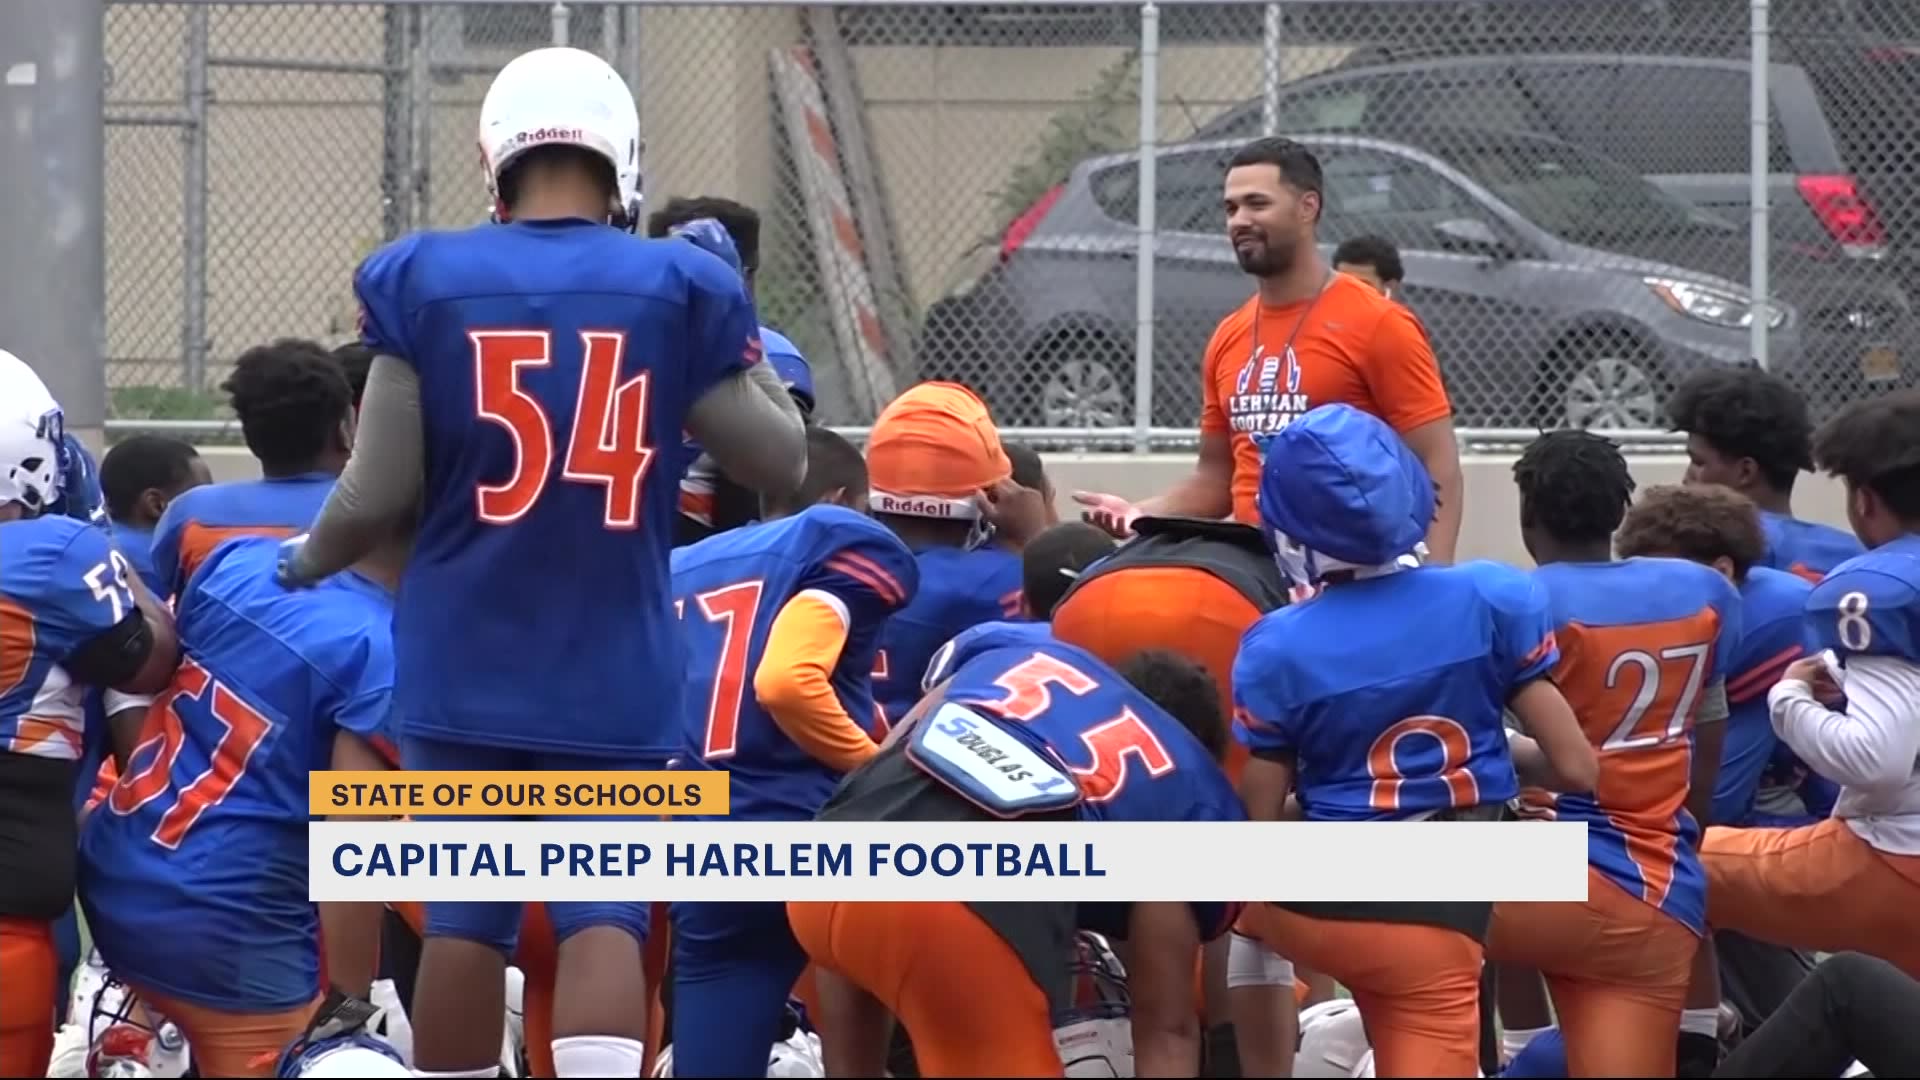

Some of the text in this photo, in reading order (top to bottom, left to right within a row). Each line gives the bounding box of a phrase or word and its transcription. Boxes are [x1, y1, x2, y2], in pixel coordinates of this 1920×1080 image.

[469, 330, 653, 530] 54
[1230, 394, 1308, 413] LEHMAN
[882, 497, 952, 517] Riddell
[1838, 591, 1871, 651] 8
[972, 652, 1175, 802] 55
[1605, 641, 1711, 751] 27
[108, 655, 274, 850] 67
